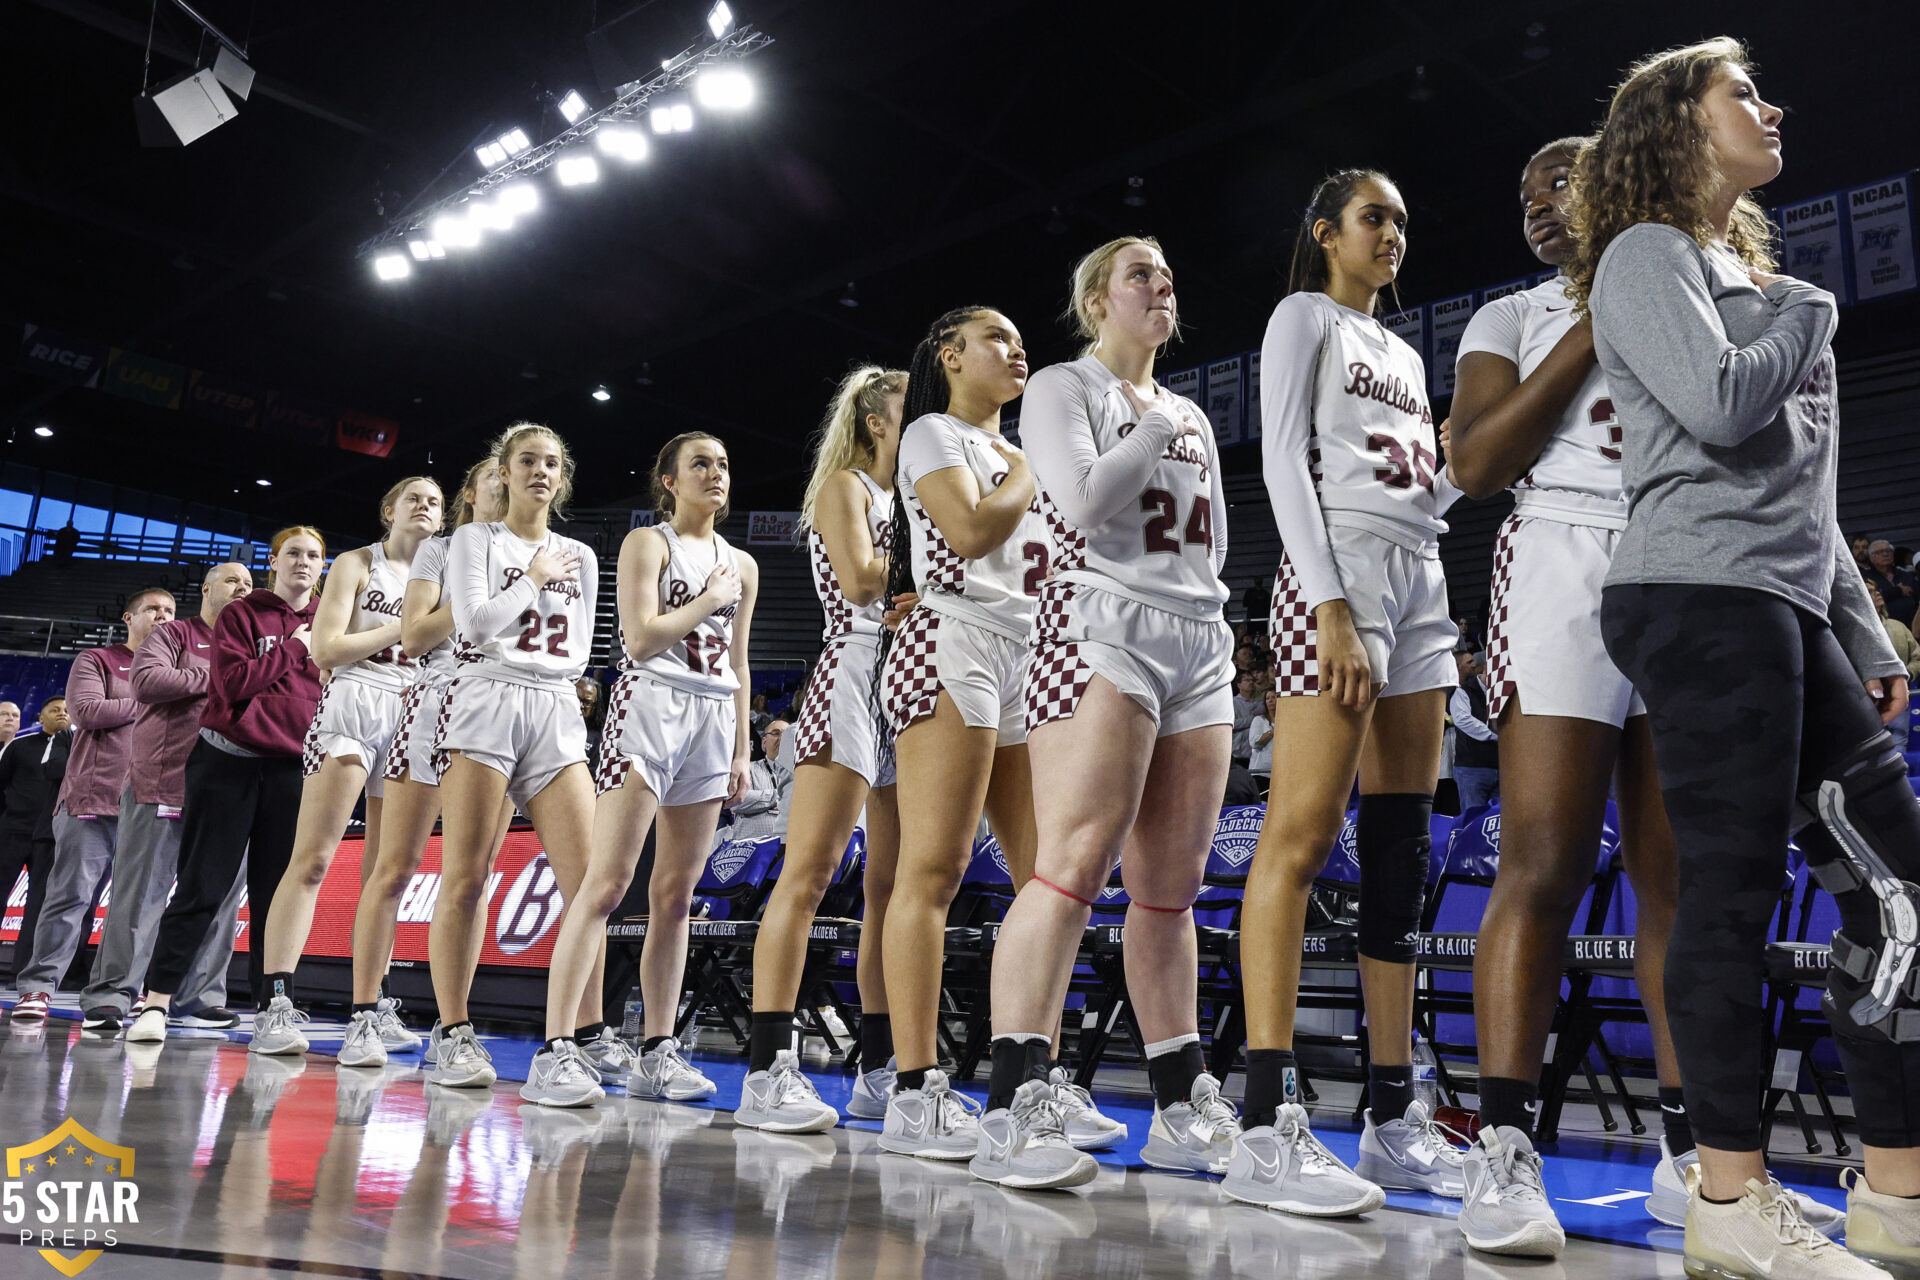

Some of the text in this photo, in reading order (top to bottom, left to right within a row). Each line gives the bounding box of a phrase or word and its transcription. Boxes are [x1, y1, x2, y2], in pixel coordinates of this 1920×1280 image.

[1852, 181, 1904, 207] NCAA
[1786, 199, 1835, 224] NCAA
[1435, 298, 1470, 316] NCAA
[29, 343, 94, 371] RICE
[1209, 360, 1238, 376] NCAA
[118, 364, 172, 393] UAB
[1169, 371, 1197, 386] NCAA
[341, 421, 389, 444] WKU
[753, 515, 777, 524] 94.9
[1139, 487, 1214, 558] 24
[516, 609, 570, 658] 22
[621, 924, 646, 936] RAIDERS
[691, 923, 737, 936] BLUE RAIDERS
[1436, 937, 1477, 956] RAIDE
[1575, 940, 1613, 959] BLUE
[1794, 950, 1835, 969] BLU
